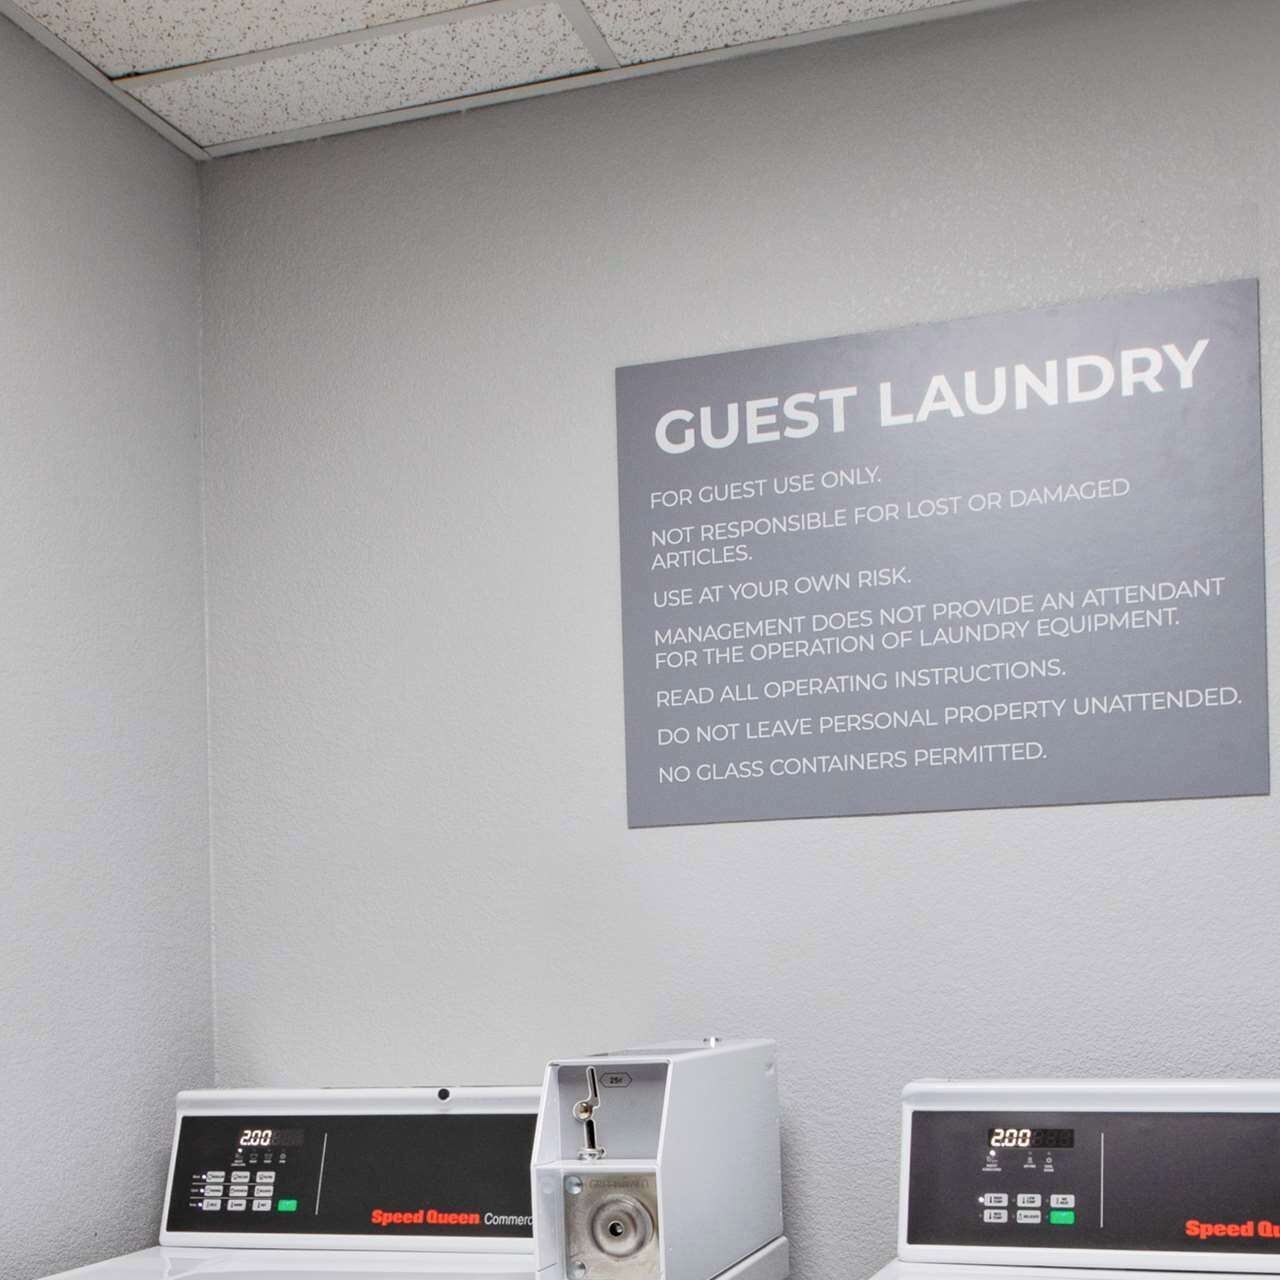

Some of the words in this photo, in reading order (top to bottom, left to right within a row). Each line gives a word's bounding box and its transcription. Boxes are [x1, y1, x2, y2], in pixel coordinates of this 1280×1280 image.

[654, 386, 858, 455] GUEST
[879, 338, 1210, 427] LAUNDRY
[650, 488, 693, 510] FOR
[698, 479, 768, 503] GUEST
[773, 473, 816, 495] USE
[820, 465, 881, 489] ONLY.
[651, 525, 695, 548] NOT
[700, 508, 848, 542] RESPONSIBLE
[854, 503, 900, 525] FOR
[906, 495, 962, 519] LOST
[967, 492, 1002, 512] OR
[1009, 478, 1130, 508] DAMAGED
[650, 544, 753, 571] ARTICLES.
[653, 587, 694, 608] USE
[698, 584, 725, 605] AT
[728, 578, 789, 601] YOUR
[794, 572, 851, 594] OWN
[858, 566, 912, 589] RISK.
[654, 615, 806, 647] MANAGEMENT
[812, 609, 873, 633] DOES
[879, 604, 927, 626] NOT
[932, 594, 1035, 621] PROVIDE
[1040, 591, 1075, 612] AN
[1081, 576, 1226, 608] ATTENDANT
[655, 649, 698, 670] FOR
[701, 644, 745, 665] THE
[750, 633, 875, 661] OPERATION
[881, 630, 913, 650] OF
[920, 619, 1030, 647] LAUNDRY
[1037, 607, 1180, 638] EQUIPMENT.
[656, 687, 715, 708] READ
[719, 683, 760, 703] ALL
[763, 672, 888, 699] OPERATING
[895, 658, 1067, 689] INSTRUCTIONS.
[657, 727, 690, 746] DO
[696, 722, 741, 743] NOT
[746, 717, 813, 740] LEAVE
[819, 708, 939, 734] PERSONAL
[944, 698, 1067, 725] PROPERTY
[1073, 686, 1242, 716] UNATTENDED.
[658, 765, 691, 784] NO
[696, 759, 765, 781] GLASS
[769, 750, 908, 776] CONTAINERS
[914, 741, 1048, 767] PERMITTED.
[371, 1208, 425, 1227] Speed
[426, 1209, 481, 1225] Queen
[1185, 1220, 1254, 1239] Speed
